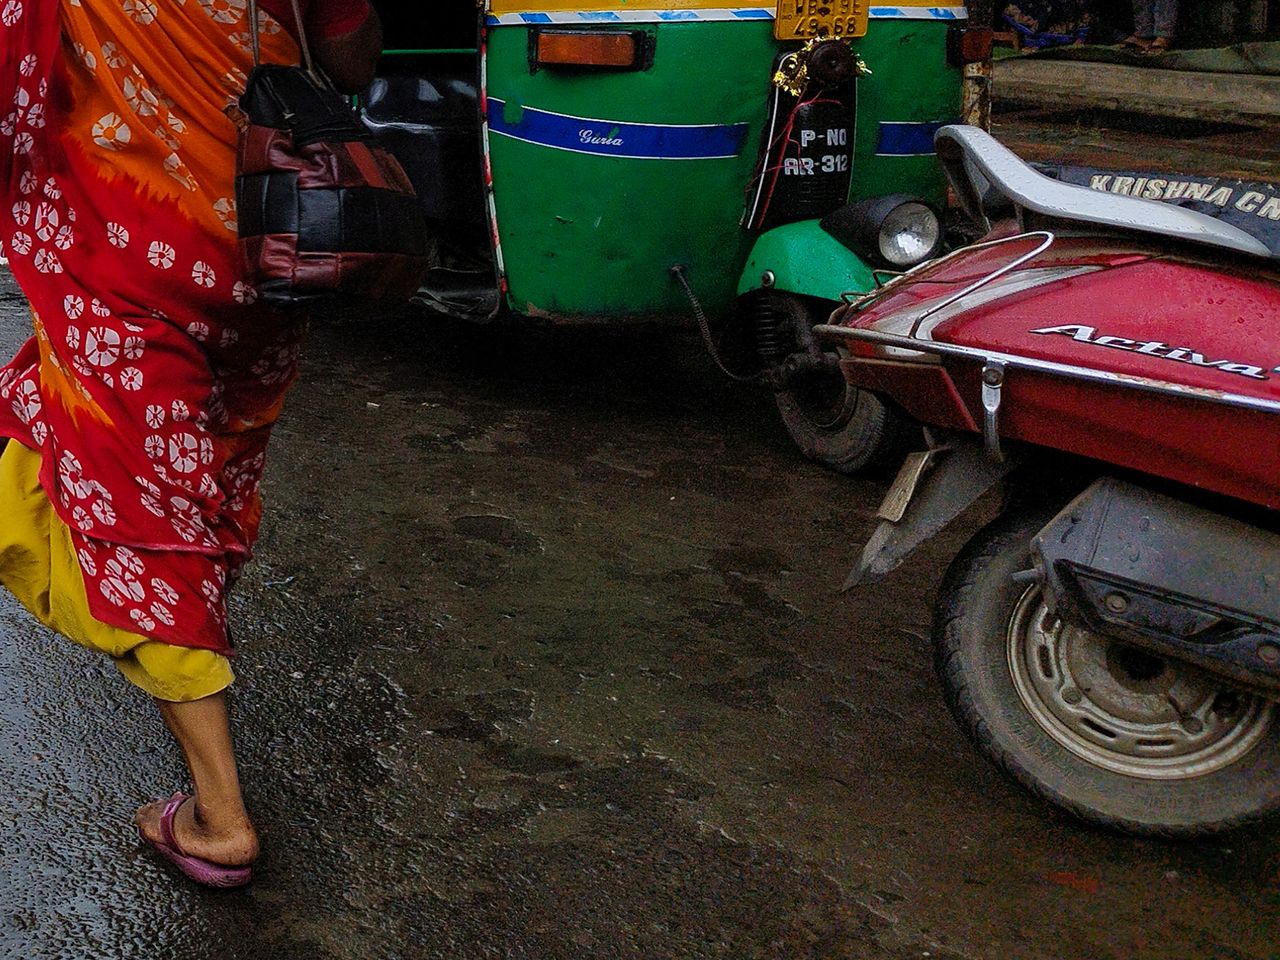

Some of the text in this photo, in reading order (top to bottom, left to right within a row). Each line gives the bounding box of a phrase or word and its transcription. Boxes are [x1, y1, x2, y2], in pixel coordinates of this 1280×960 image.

[800, 129, 847, 147] P-NO
[783, 154, 848, 176] AR-312
[1090, 174, 1233, 208] KRISHNA
[1029, 324, 1270, 380] Activa
